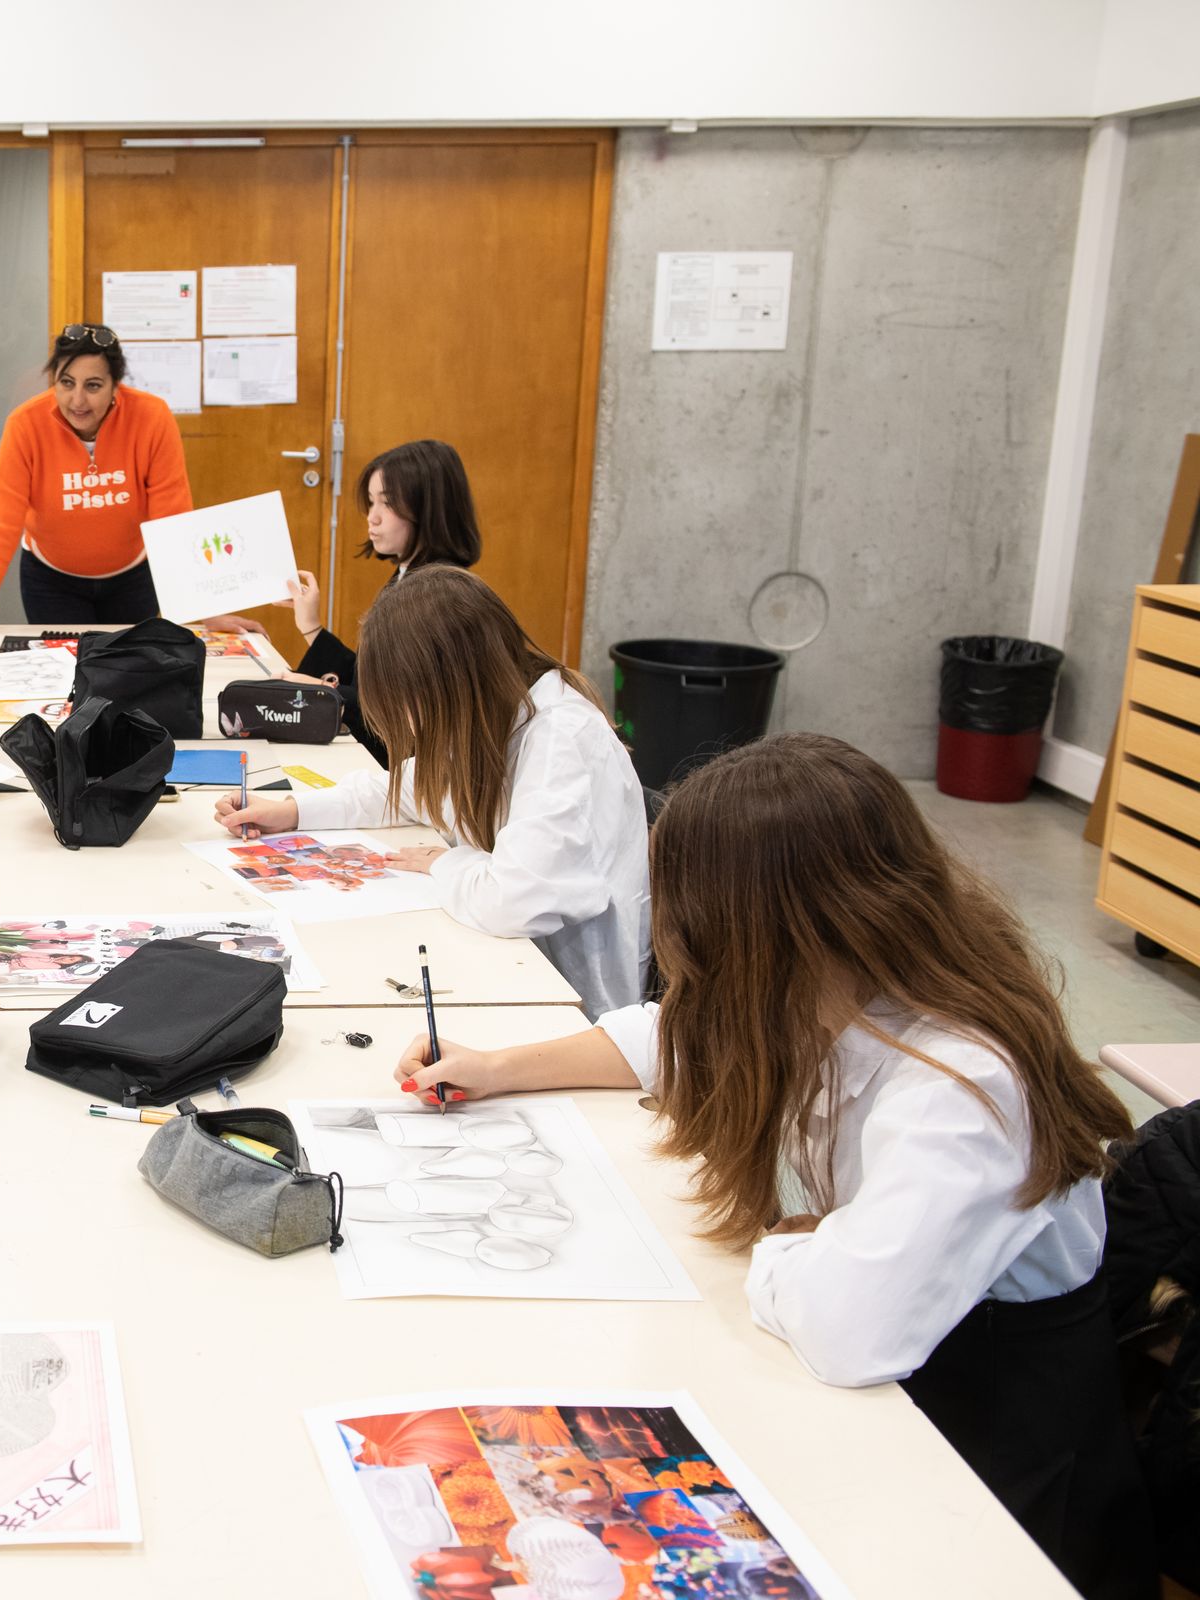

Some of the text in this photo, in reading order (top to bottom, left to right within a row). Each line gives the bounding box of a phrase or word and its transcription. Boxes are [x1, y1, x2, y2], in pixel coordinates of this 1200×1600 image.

[62, 470, 126, 491] Hors
[62, 490, 131, 511] Piste
[264, 709, 301, 724] Kwell
